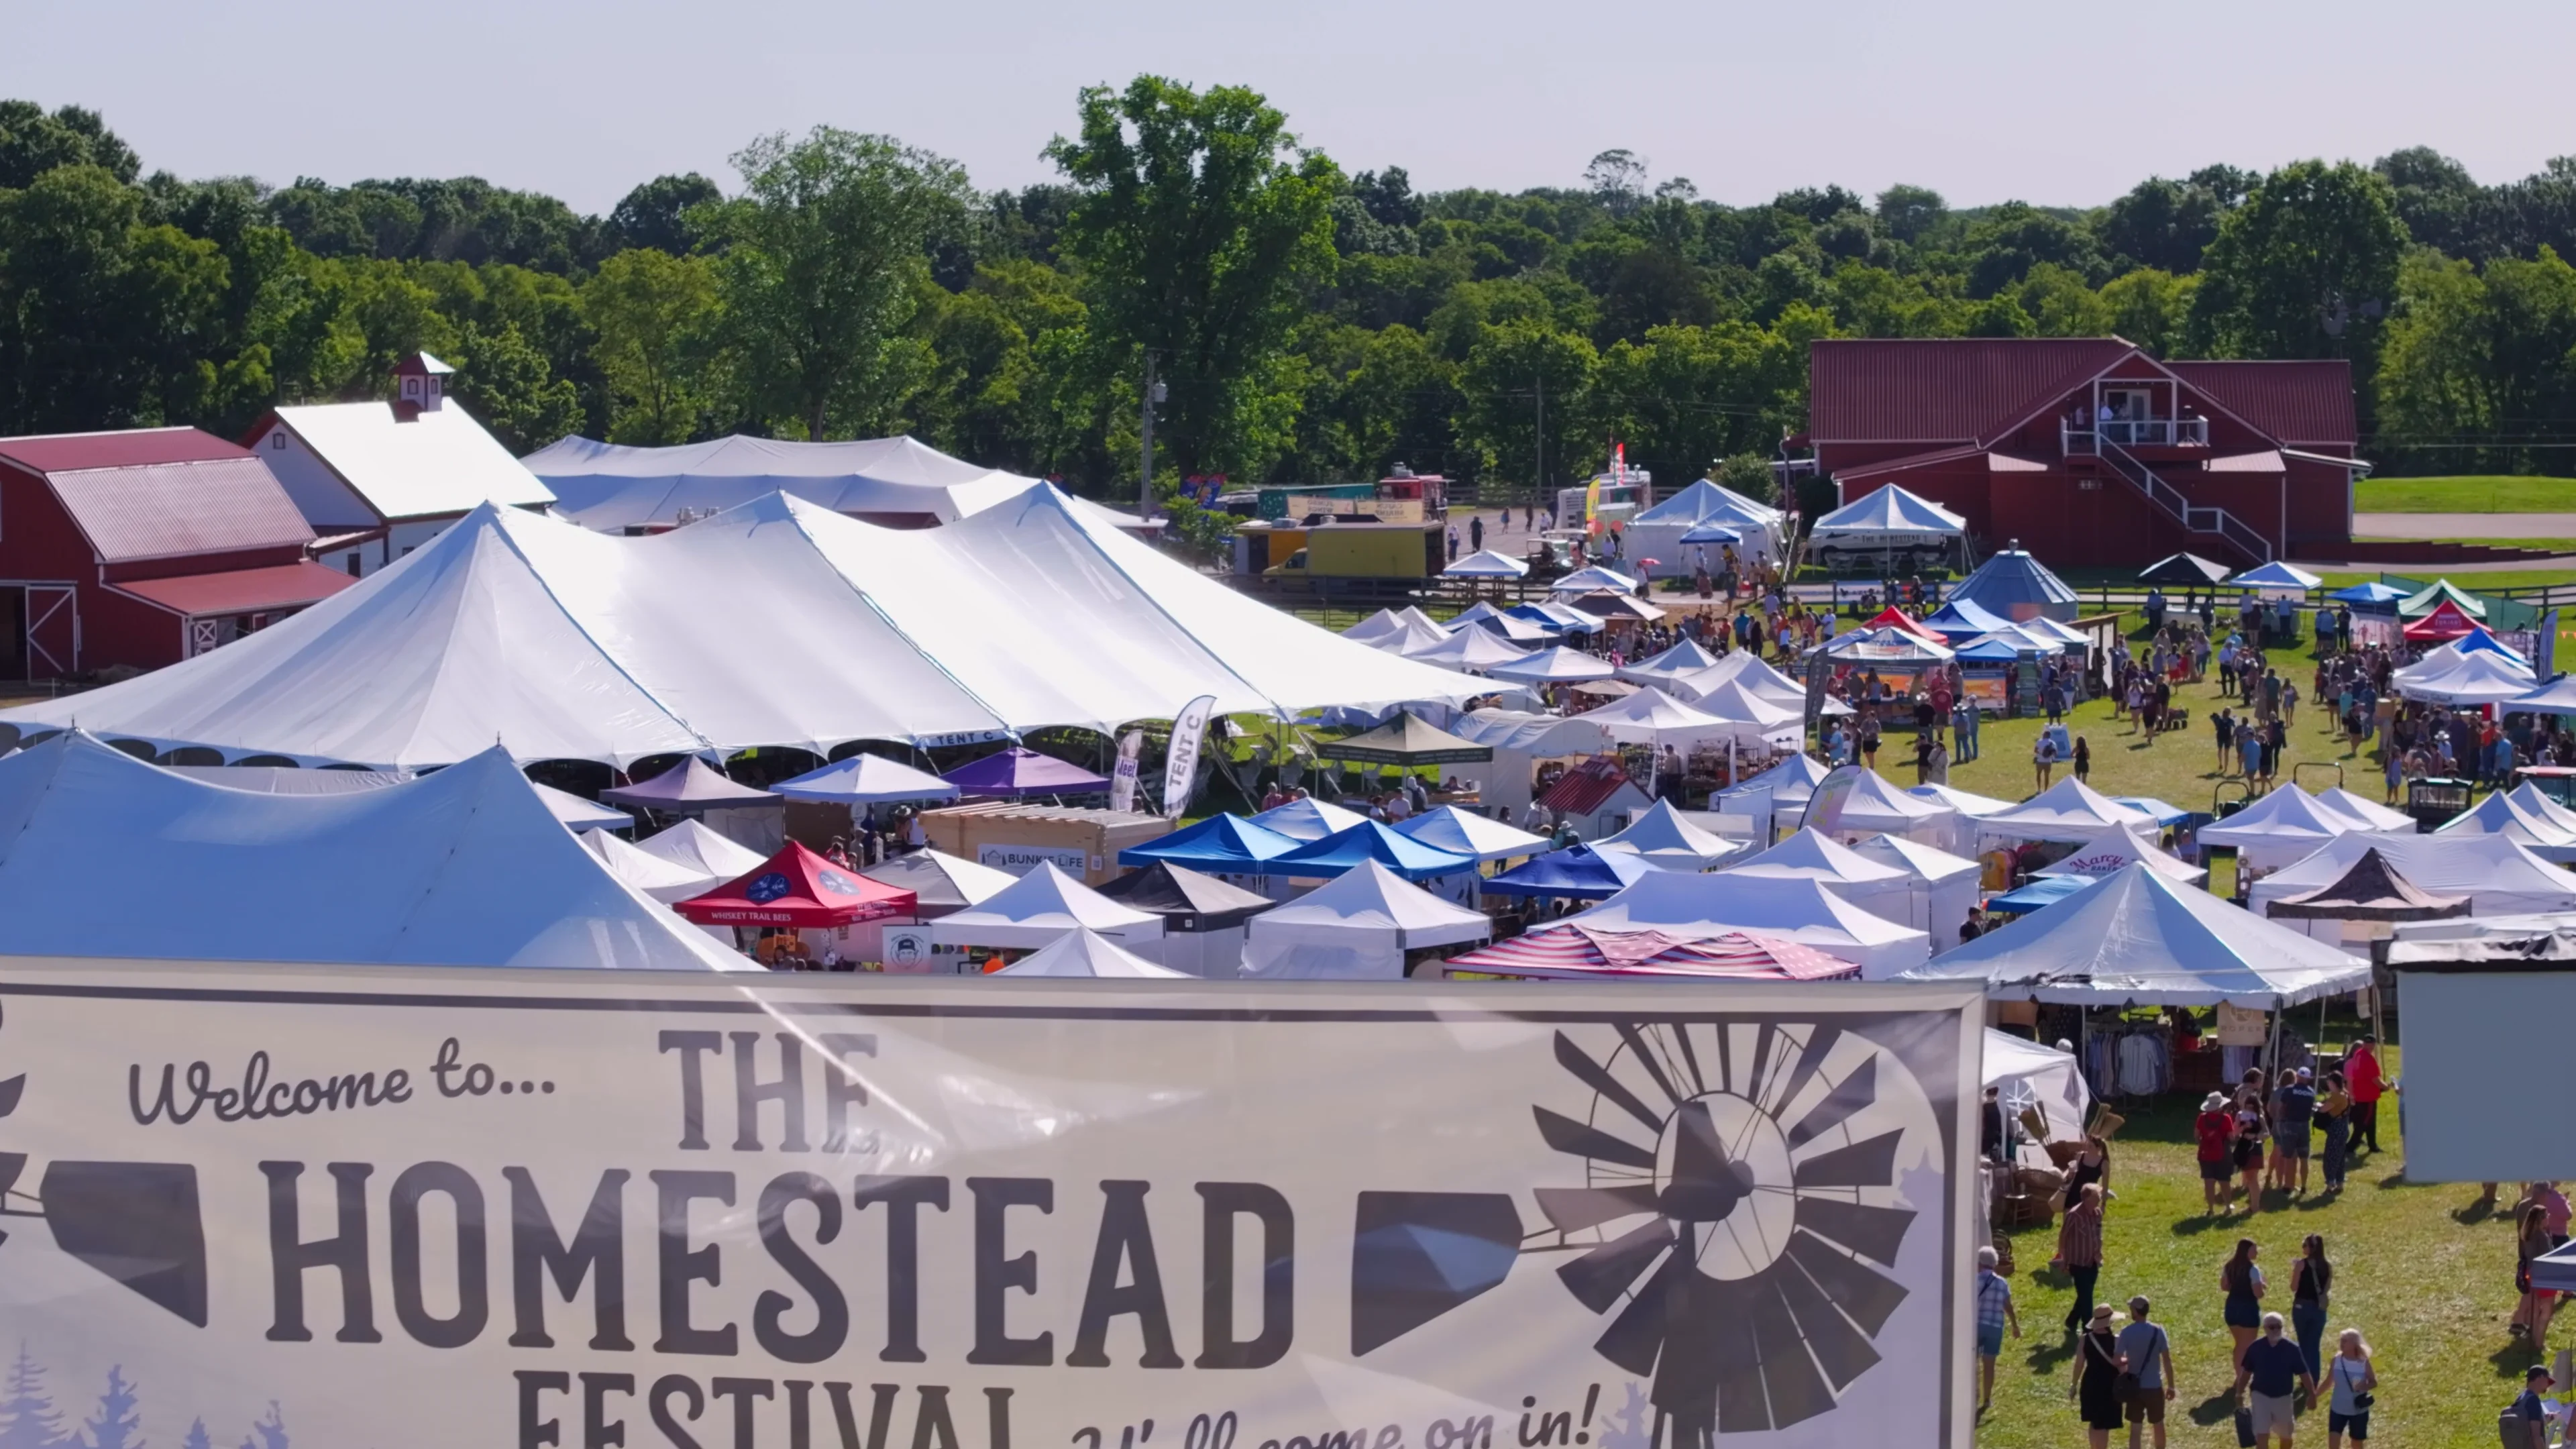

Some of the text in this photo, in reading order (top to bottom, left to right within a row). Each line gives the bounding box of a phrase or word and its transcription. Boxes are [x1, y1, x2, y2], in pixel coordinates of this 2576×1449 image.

[936, 731, 994, 745] TENT C
[1169, 714, 1201, 788] TENT C
[711, 912, 792, 922] WHISKEY TRAIL BEES
[128, 1036, 555, 1126] Welcome to...
[658, 1030, 880, 1154] THE
[258, 1160, 1295, 1370] HOMESTEAD
[1424, 1413, 1495, 1449] on
[1517, 1382, 1601, 1448] in!
